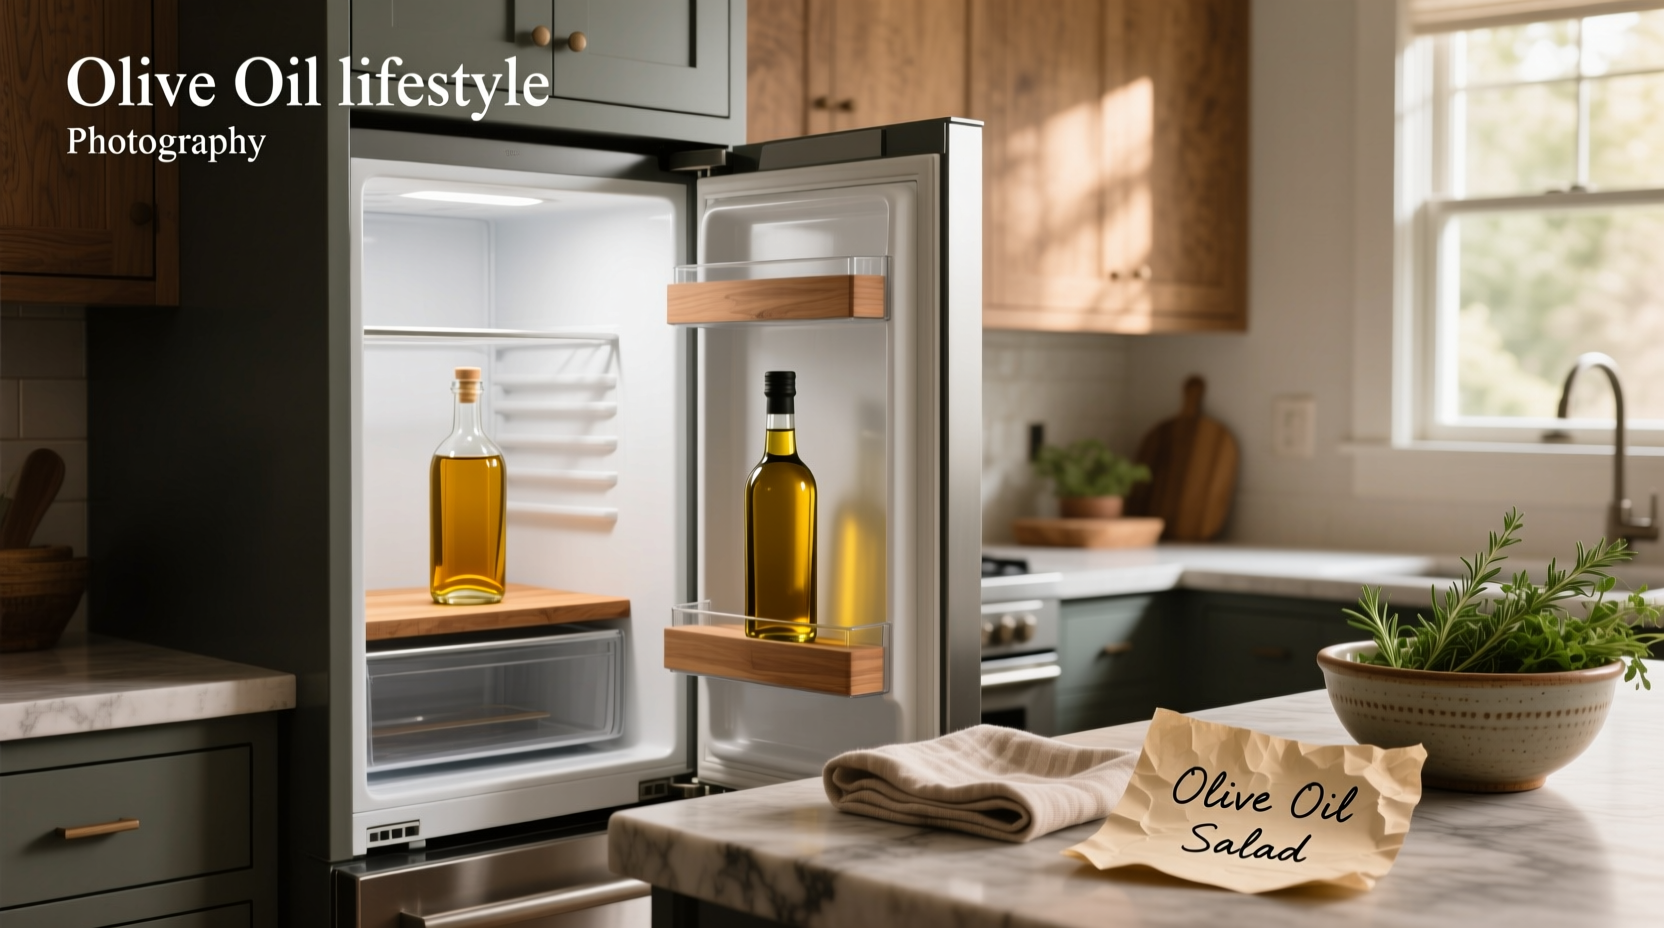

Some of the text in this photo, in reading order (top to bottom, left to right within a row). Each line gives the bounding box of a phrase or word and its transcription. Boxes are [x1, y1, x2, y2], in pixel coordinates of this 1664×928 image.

[1172, 766, 1359, 823] Olive Oil
[1181, 823, 1312, 863] Salad
